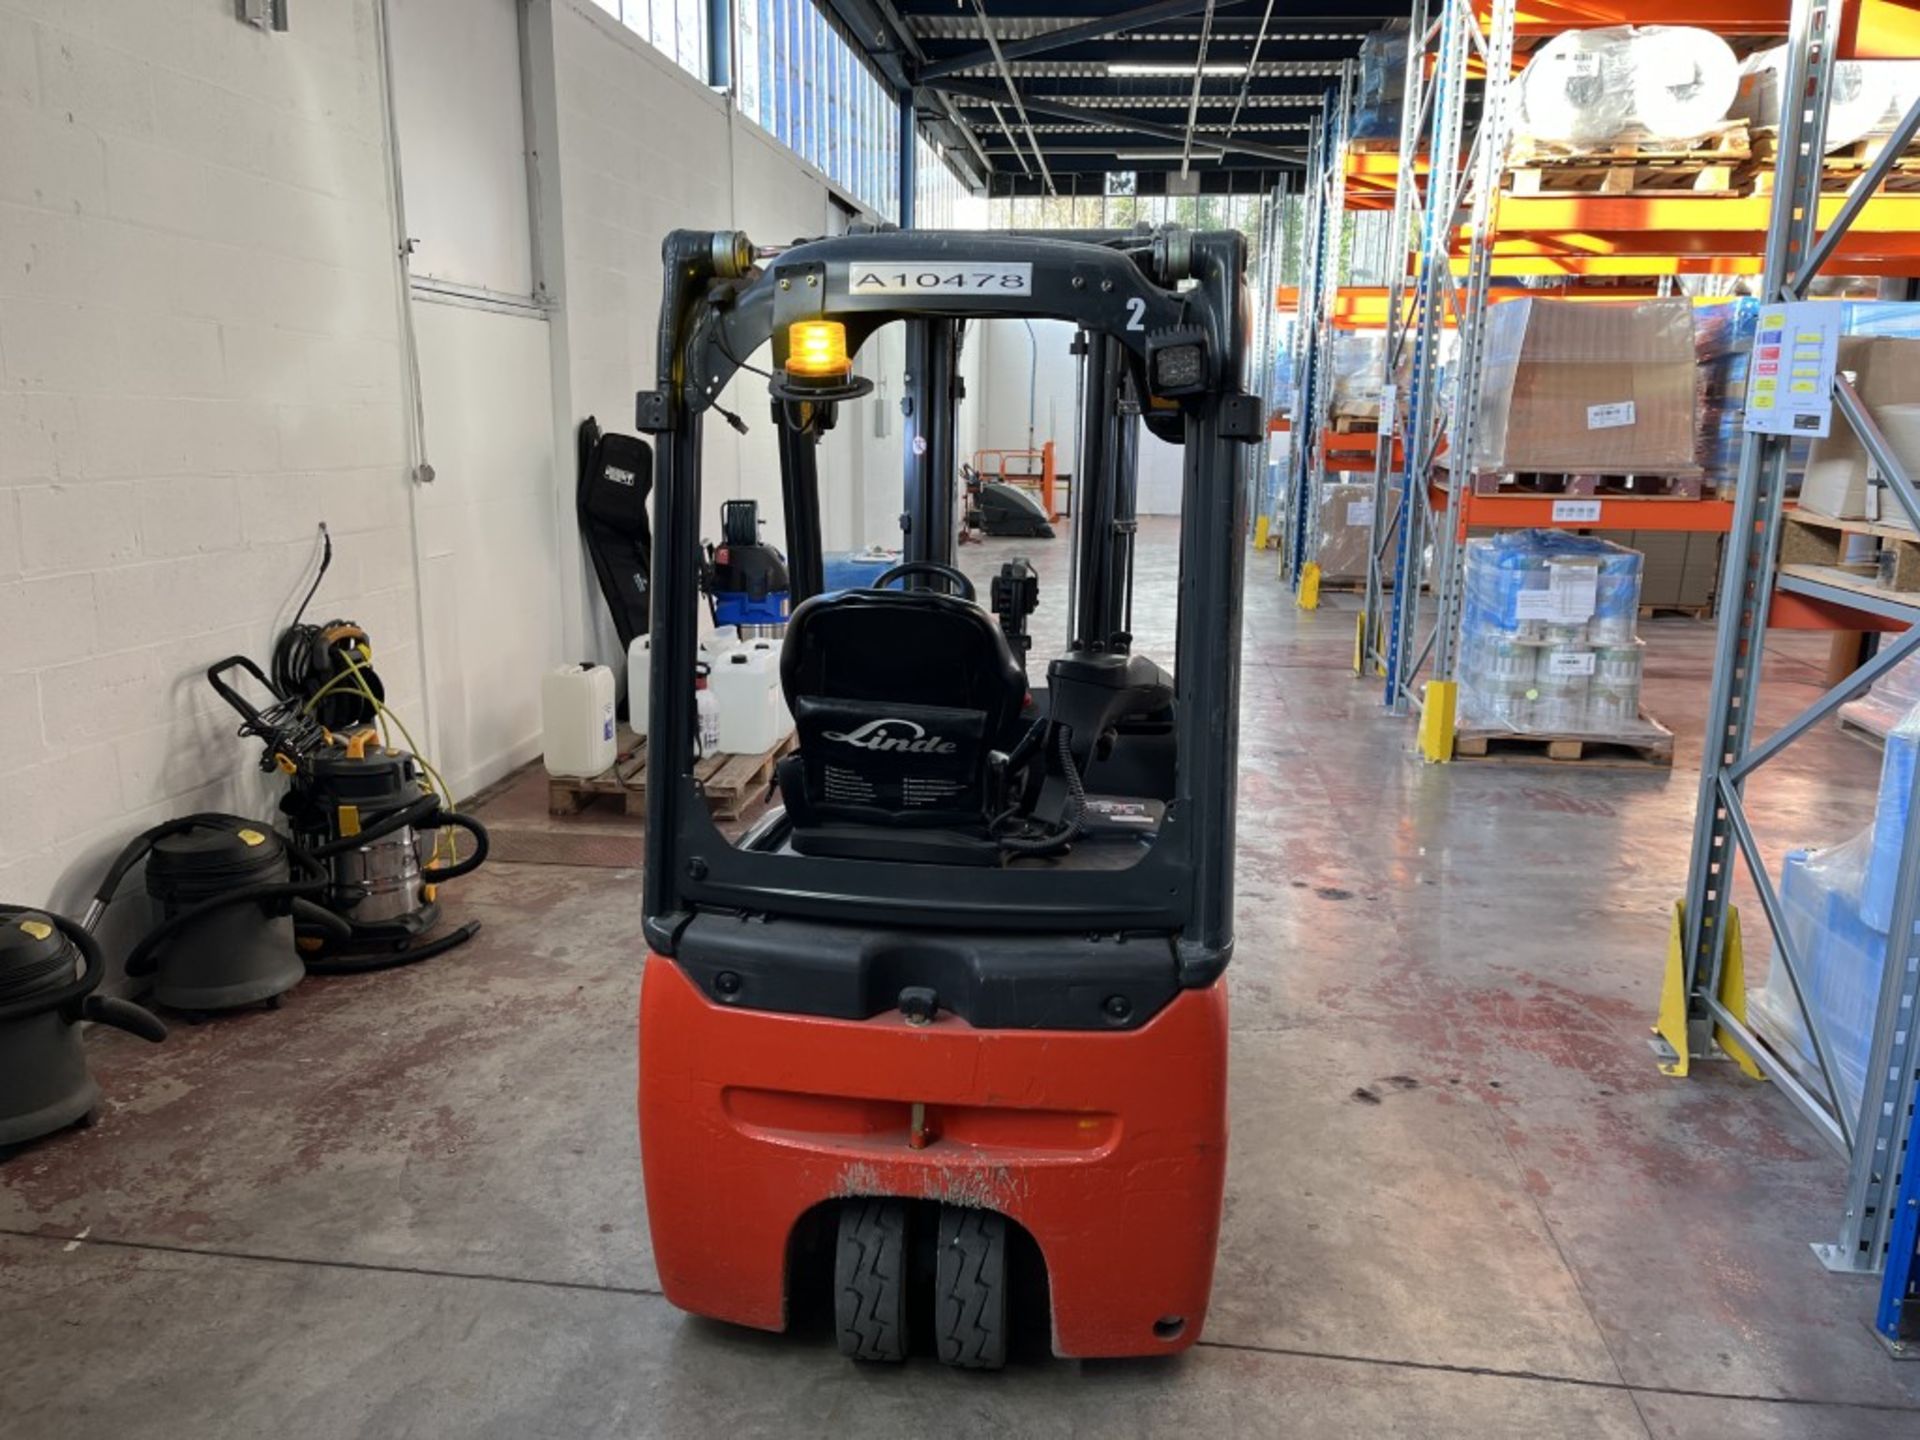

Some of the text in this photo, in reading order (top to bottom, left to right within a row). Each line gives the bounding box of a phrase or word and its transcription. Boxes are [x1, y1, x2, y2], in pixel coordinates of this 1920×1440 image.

[855, 272, 1025, 290] A10478
[1125, 297, 1147, 332] 2
[822, 718, 956, 753] Linde
